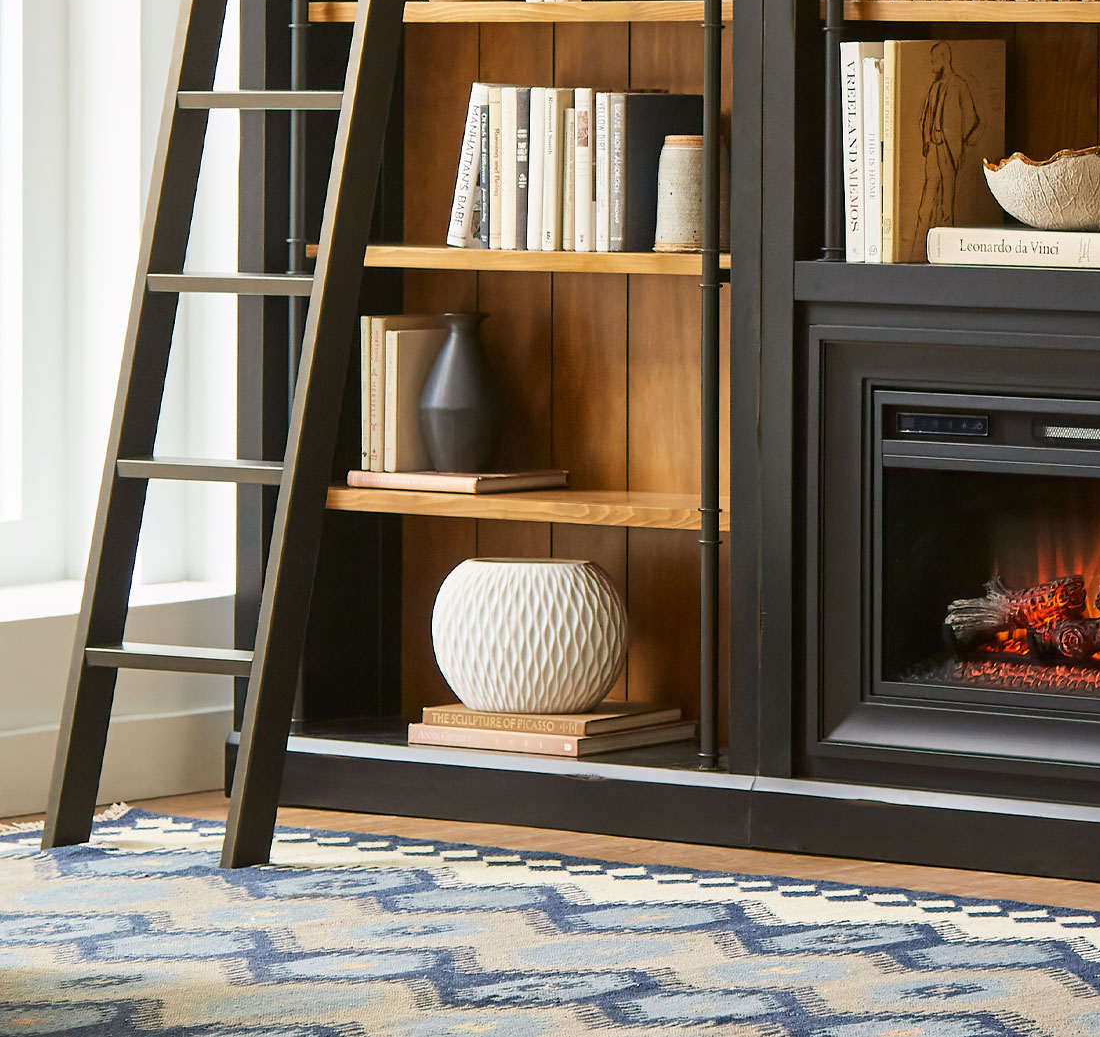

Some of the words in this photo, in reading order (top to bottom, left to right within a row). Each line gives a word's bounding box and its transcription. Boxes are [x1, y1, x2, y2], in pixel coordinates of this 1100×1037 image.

[597, 102, 606, 131] YELLOW
[846, 60, 857, 163] VREELAND
[459, 104, 480, 191] MANHATTAN'S
[597, 134, 606, 151] DIRT
[868, 133, 877, 155] THIS
[493, 159, 501, 174] and
[868, 168, 877, 200] HOME
[454, 194, 469, 227] BABE
[849, 167, 859, 232] MEMOS
[960, 239, 1012, 254] Leonardo
[1015, 240, 1028, 254] da
[1030, 241, 1059, 255] Vinci
[431, 712, 450, 724] THE
[451, 713, 501, 728] SCULPTURE
[502, 717, 517, 730] OF
[517, 719, 555, 733] PICASSO
